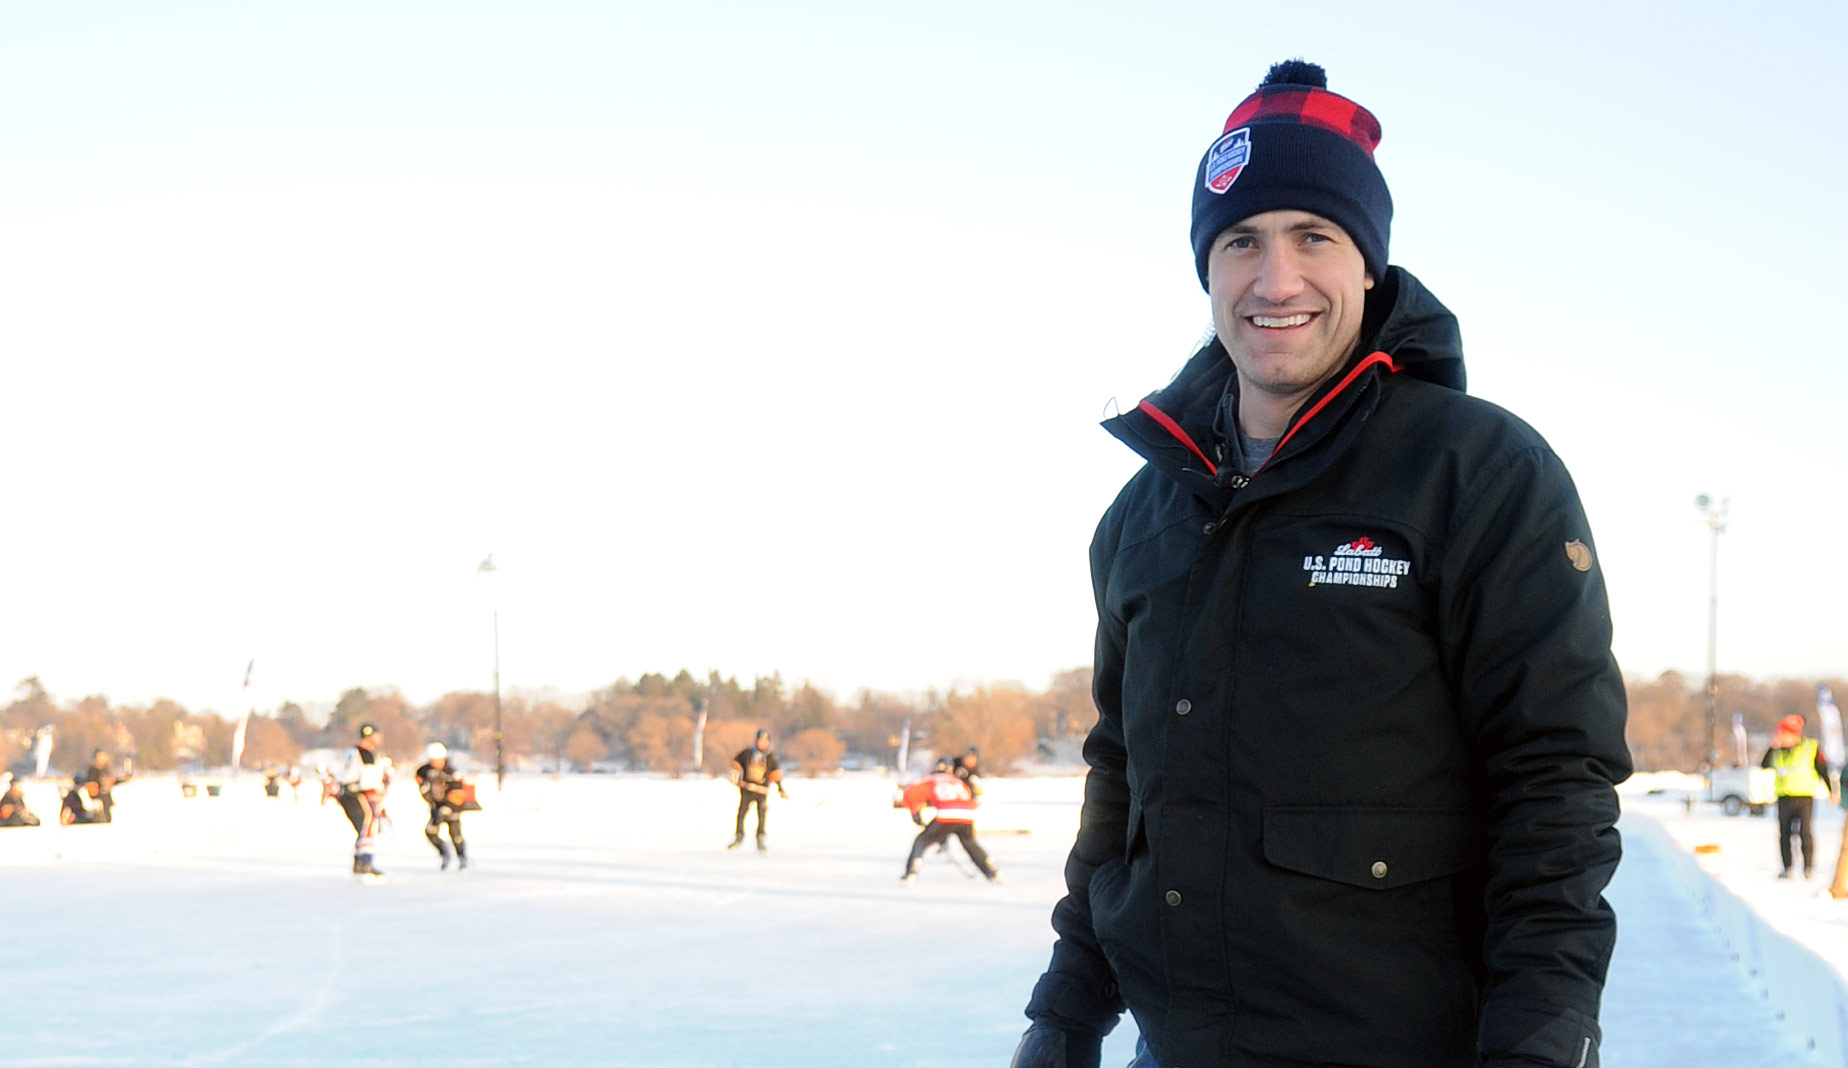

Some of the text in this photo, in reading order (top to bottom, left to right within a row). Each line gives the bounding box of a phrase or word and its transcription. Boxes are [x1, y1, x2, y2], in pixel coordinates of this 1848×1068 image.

[1334, 544, 1382, 556] Labatt
[1303, 556, 1410, 575] U.S. POND HOCKEY
[1311, 571, 1397, 588] CHAMPIONSHIPS
